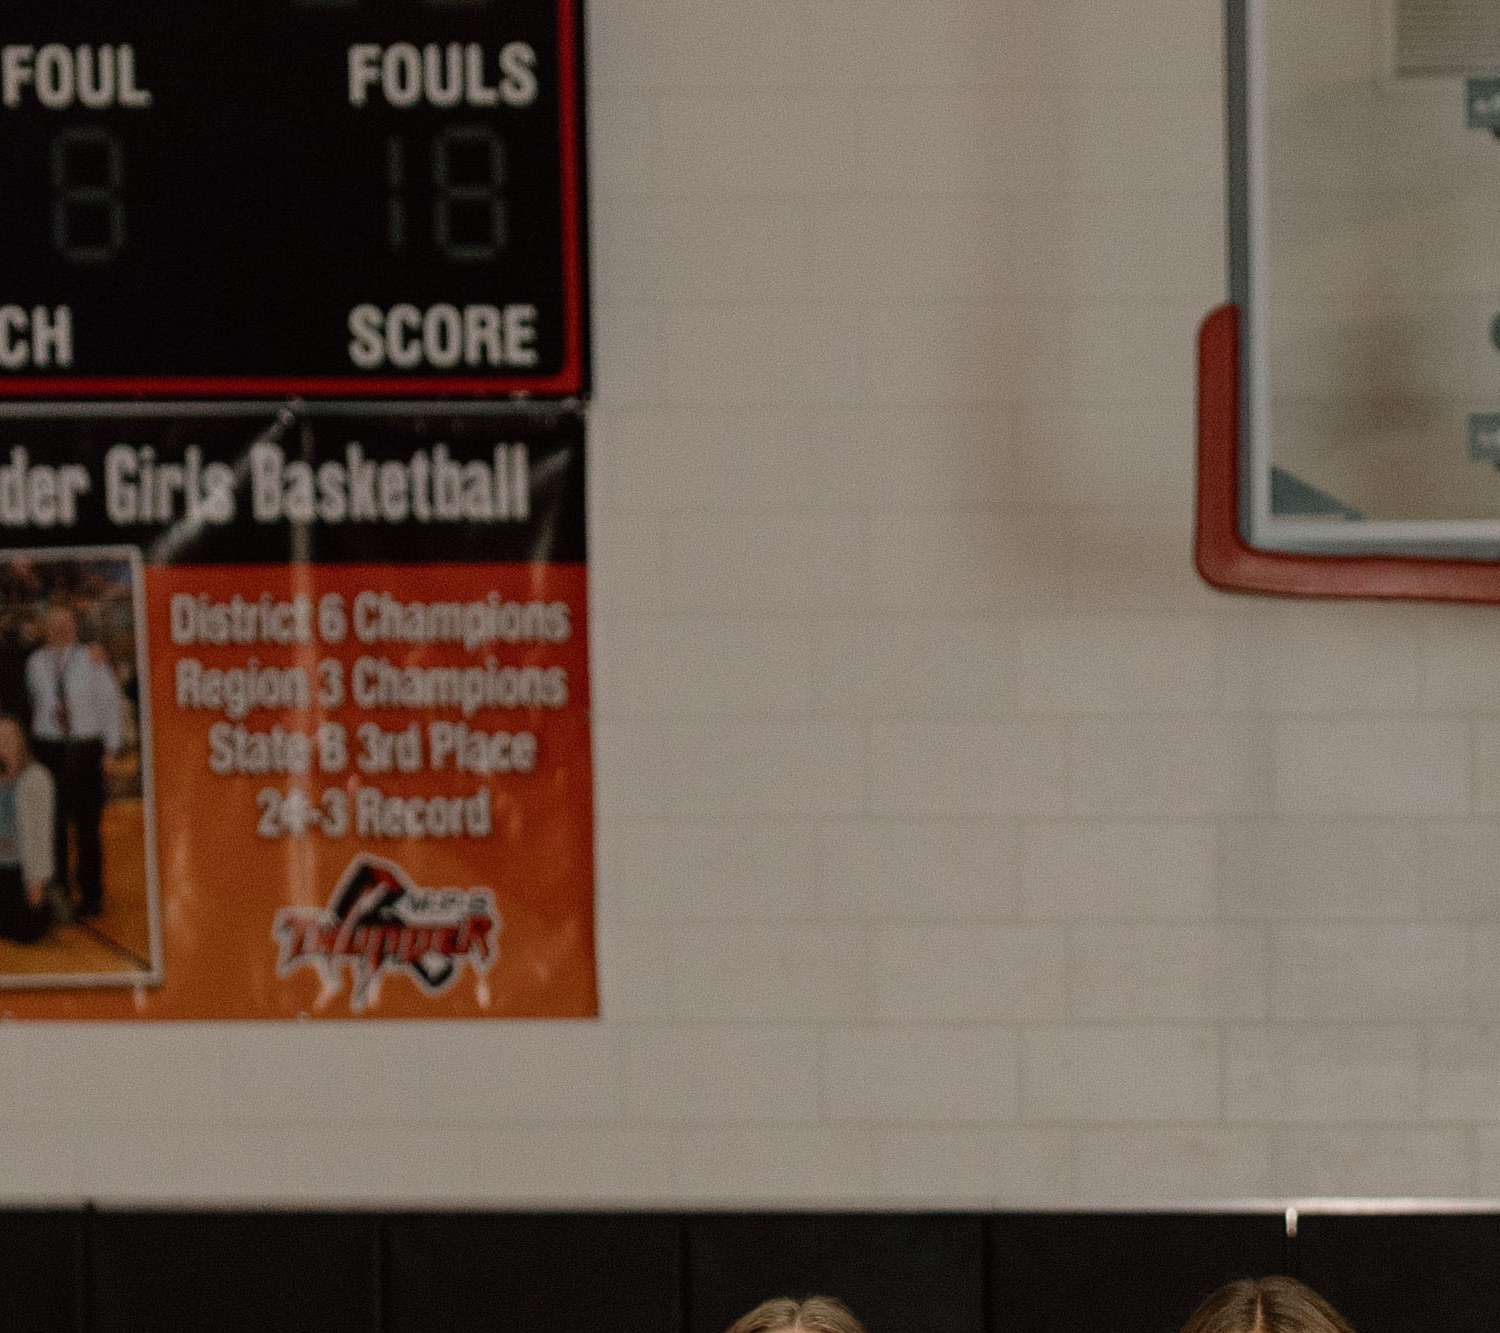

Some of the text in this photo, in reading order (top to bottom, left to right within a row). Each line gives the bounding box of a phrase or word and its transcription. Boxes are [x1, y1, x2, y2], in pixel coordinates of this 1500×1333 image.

[1, 42, 153, 108] FOUL
[347, 40, 539, 108] FOULS
[346, 302, 539, 369] SCORE
[104, 443, 237, 526] Girls
[248, 440, 532, 525] Basketball
[170, 589, 573, 653] District 6 Champions
[174, 654, 569, 721] Region 3 Champions
[206, 720, 312, 776] State
[355, 719, 423, 774] 3rd
[428, 719, 538, 775] Place
[354, 785, 494, 838] Record
